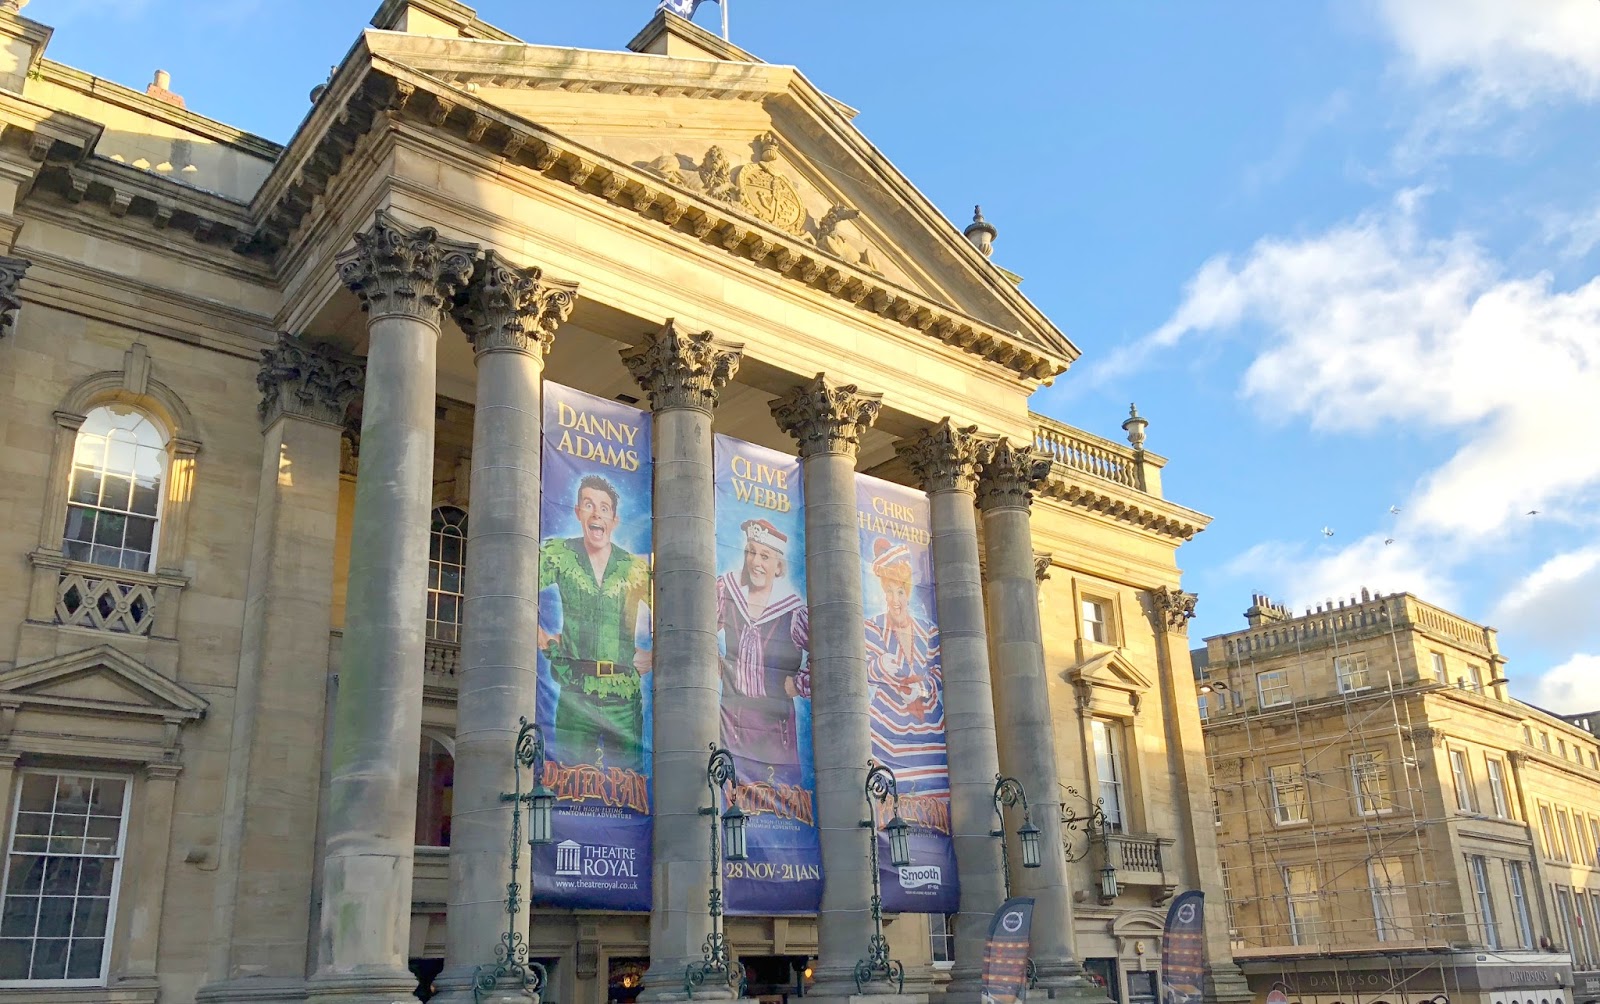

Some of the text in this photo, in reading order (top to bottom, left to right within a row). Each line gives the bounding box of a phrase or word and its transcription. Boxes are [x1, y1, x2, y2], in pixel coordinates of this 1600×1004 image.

[558, 401, 638, 446] DANNY
[557, 430, 638, 471] ADAMS
[731, 456, 787, 490] CLIVE
[731, 477, 790, 512] WEBB
[873, 497, 914, 523] CHRIS
[860, 511, 930, 545] HAYWARD
[542, 760, 649, 815] PETER PAN
[558, 810, 632, 820] PANTOMIME ADVENTURE
[583, 806, 623, 814] HIGH-FLYING
[777, 783, 814, 827] PAN
[584, 845, 636, 860] THEATRE
[584, 859, 638, 877] ROYAL
[726, 862, 743, 878] 28
[744, 861, 776, 879] NOV
[782, 863, 794, 879] 21
[795, 864, 820, 882] JAN
[901, 868, 939, 880] Smooth
[556, 880, 638, 891] www.theatreroyal.co.uk
[1310, 971, 1401, 987] DAVIDSONS
[1509, 970, 1549, 983] DAVIDSONS
